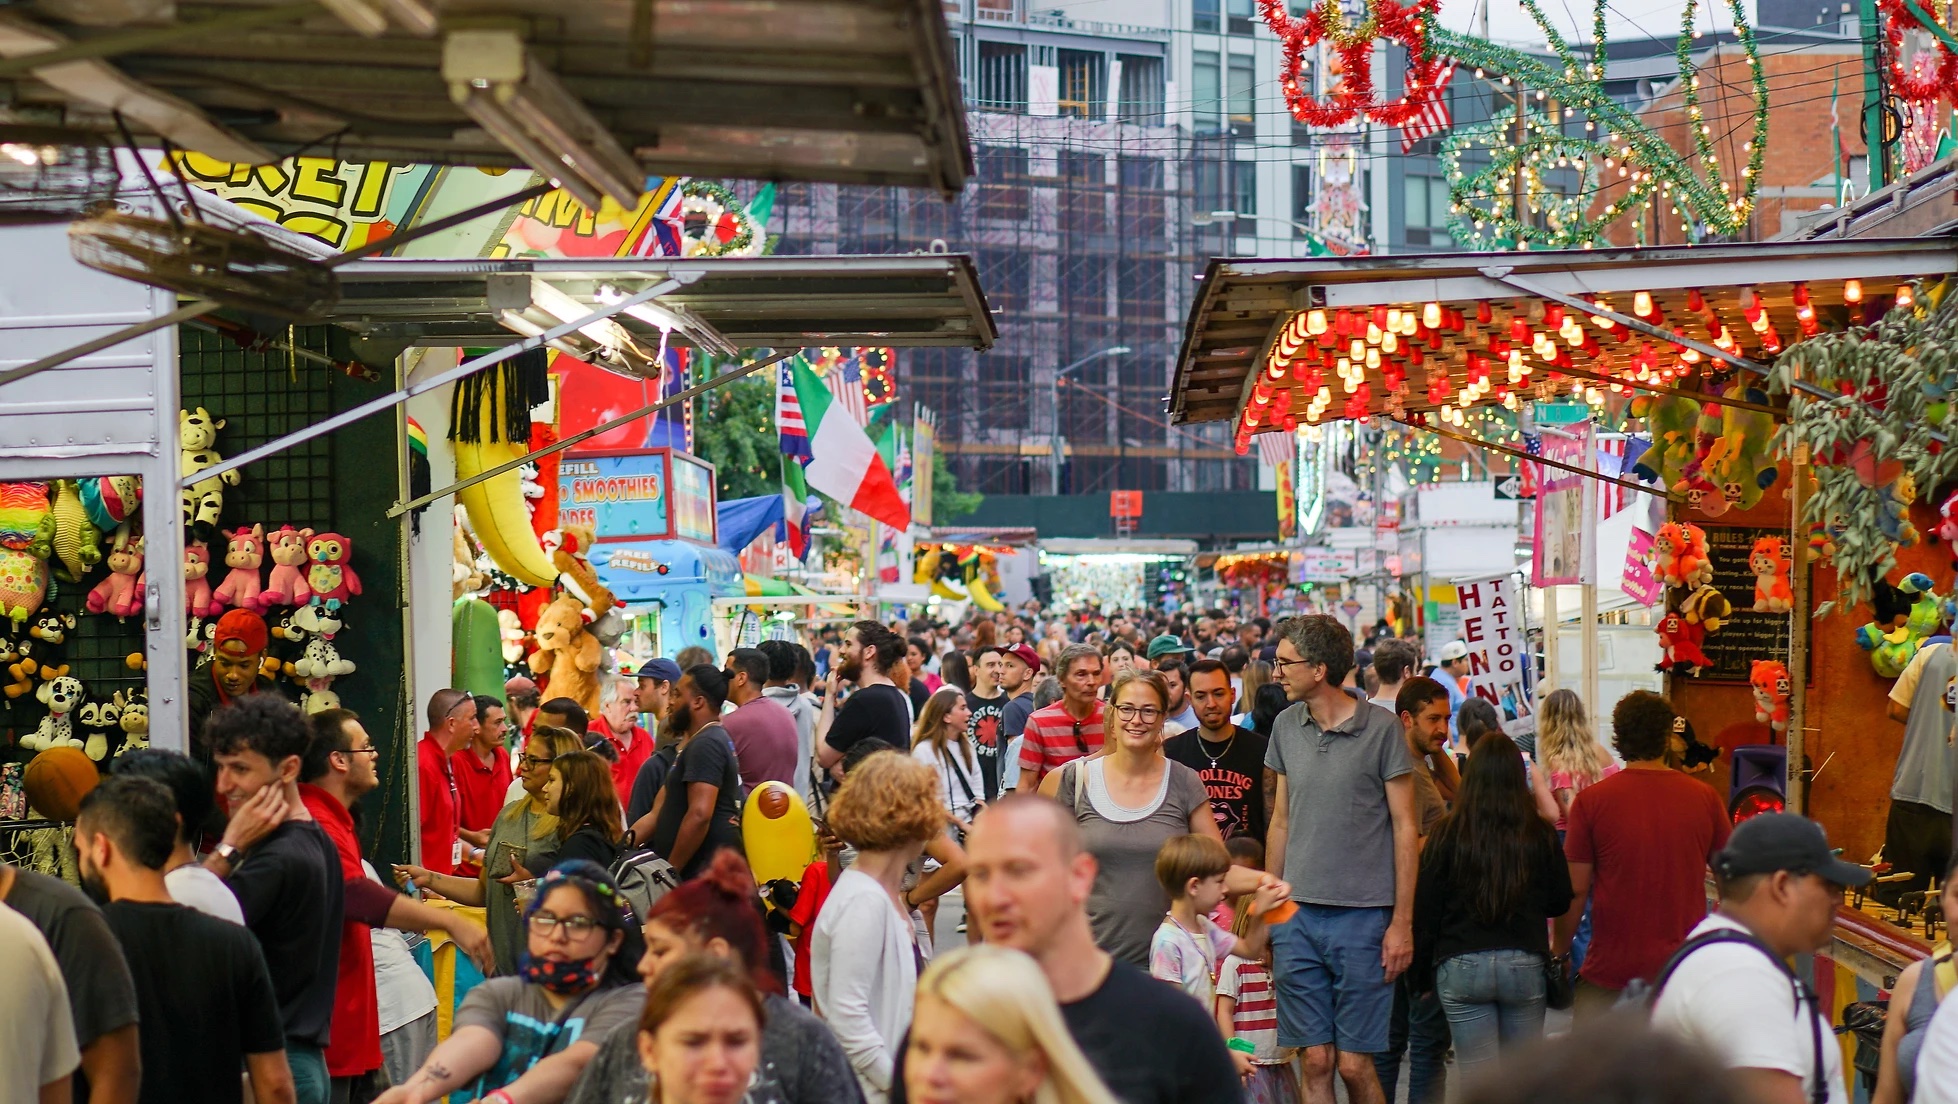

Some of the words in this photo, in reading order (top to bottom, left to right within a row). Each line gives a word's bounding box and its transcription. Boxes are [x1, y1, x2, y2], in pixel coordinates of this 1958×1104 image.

[1537, 406, 1547, 421] N
[559, 463, 599, 475] EFILL
[573, 476, 658, 503] SMOOTHIES
[1712, 533, 1744, 543] RULES
[614, 549, 650, 559] FREE
[610, 558, 659, 572] REFILL
[1489, 579, 1515, 673] TATTOO
[1198, 768, 1253, 791] OLLING
[1205, 785, 1244, 800] ONES
